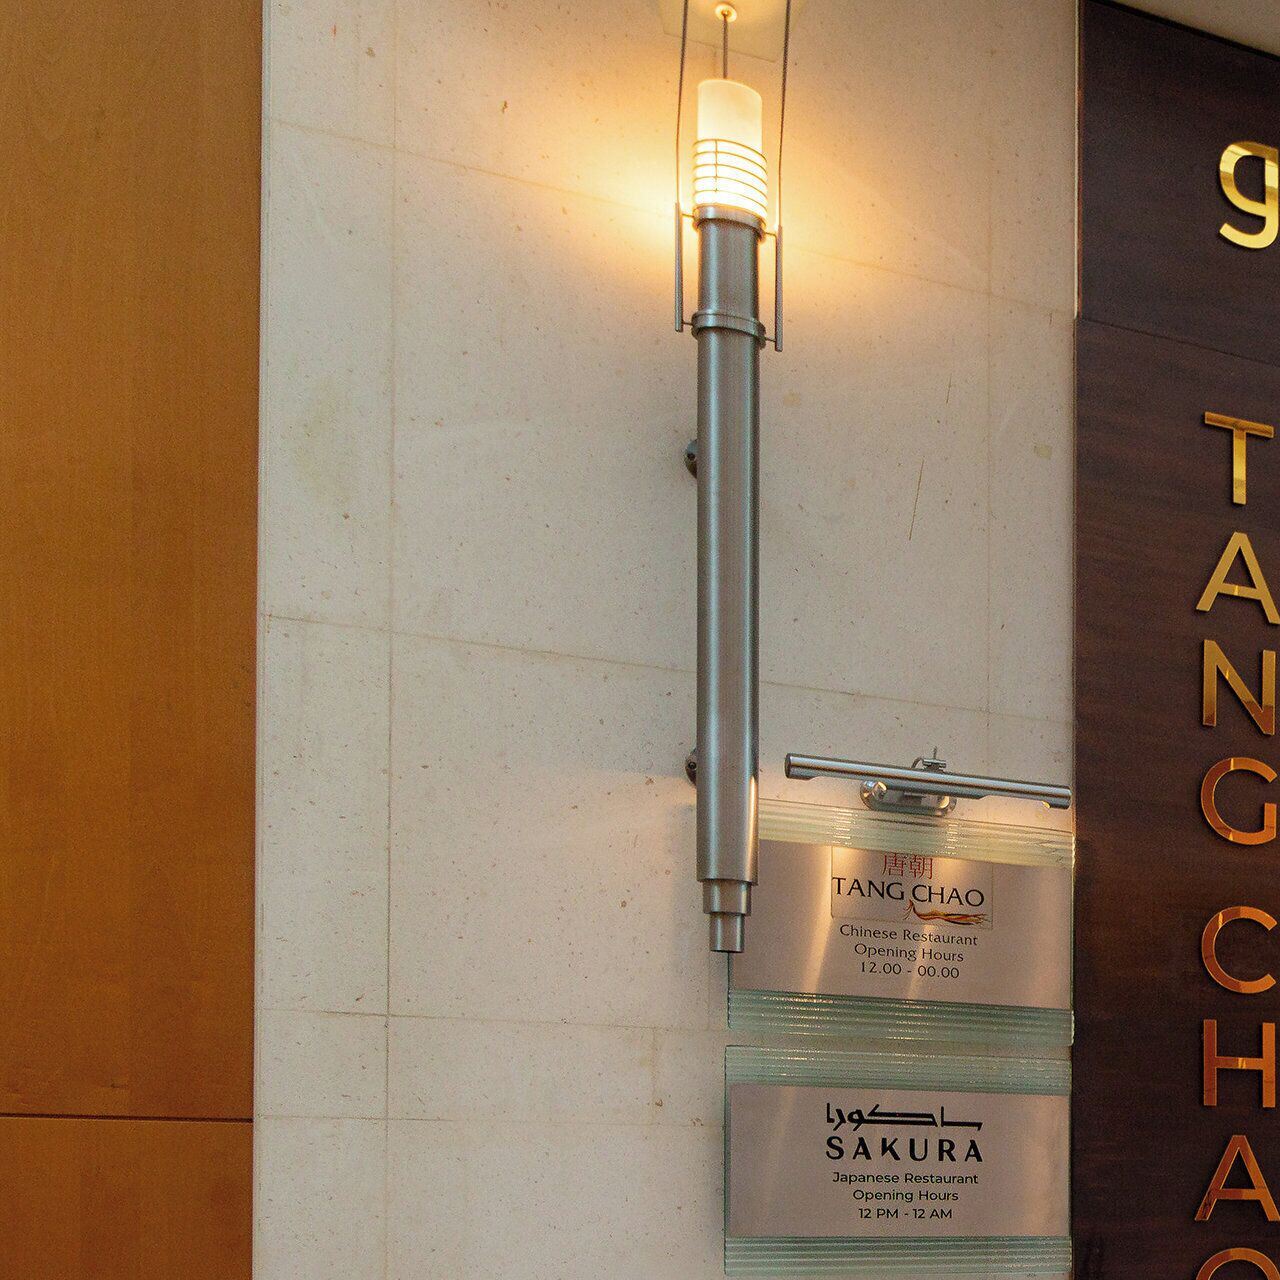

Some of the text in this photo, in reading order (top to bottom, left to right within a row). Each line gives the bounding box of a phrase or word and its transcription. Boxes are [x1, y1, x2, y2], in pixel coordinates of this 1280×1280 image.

[832, 876, 985, 907] TANG CHAO
[839, 924, 978, 946] Chinese Restaurant
[854, 943, 964, 962] Opening Hours
[860, 961, 902, 975] 12.00
[917, 964, 960, 979] 00.00
[825, 1135, 983, 1162] SAKURA
[832, 1172, 979, 1185] Japanese Restaurant
[853, 1189, 959, 1203] Opening Hours
[858, 1208, 872, 1219] 12
[876, 1208, 899, 1219] PM
[912, 1208, 926, 1219] 12
[929, 1208, 953, 1219] AM
